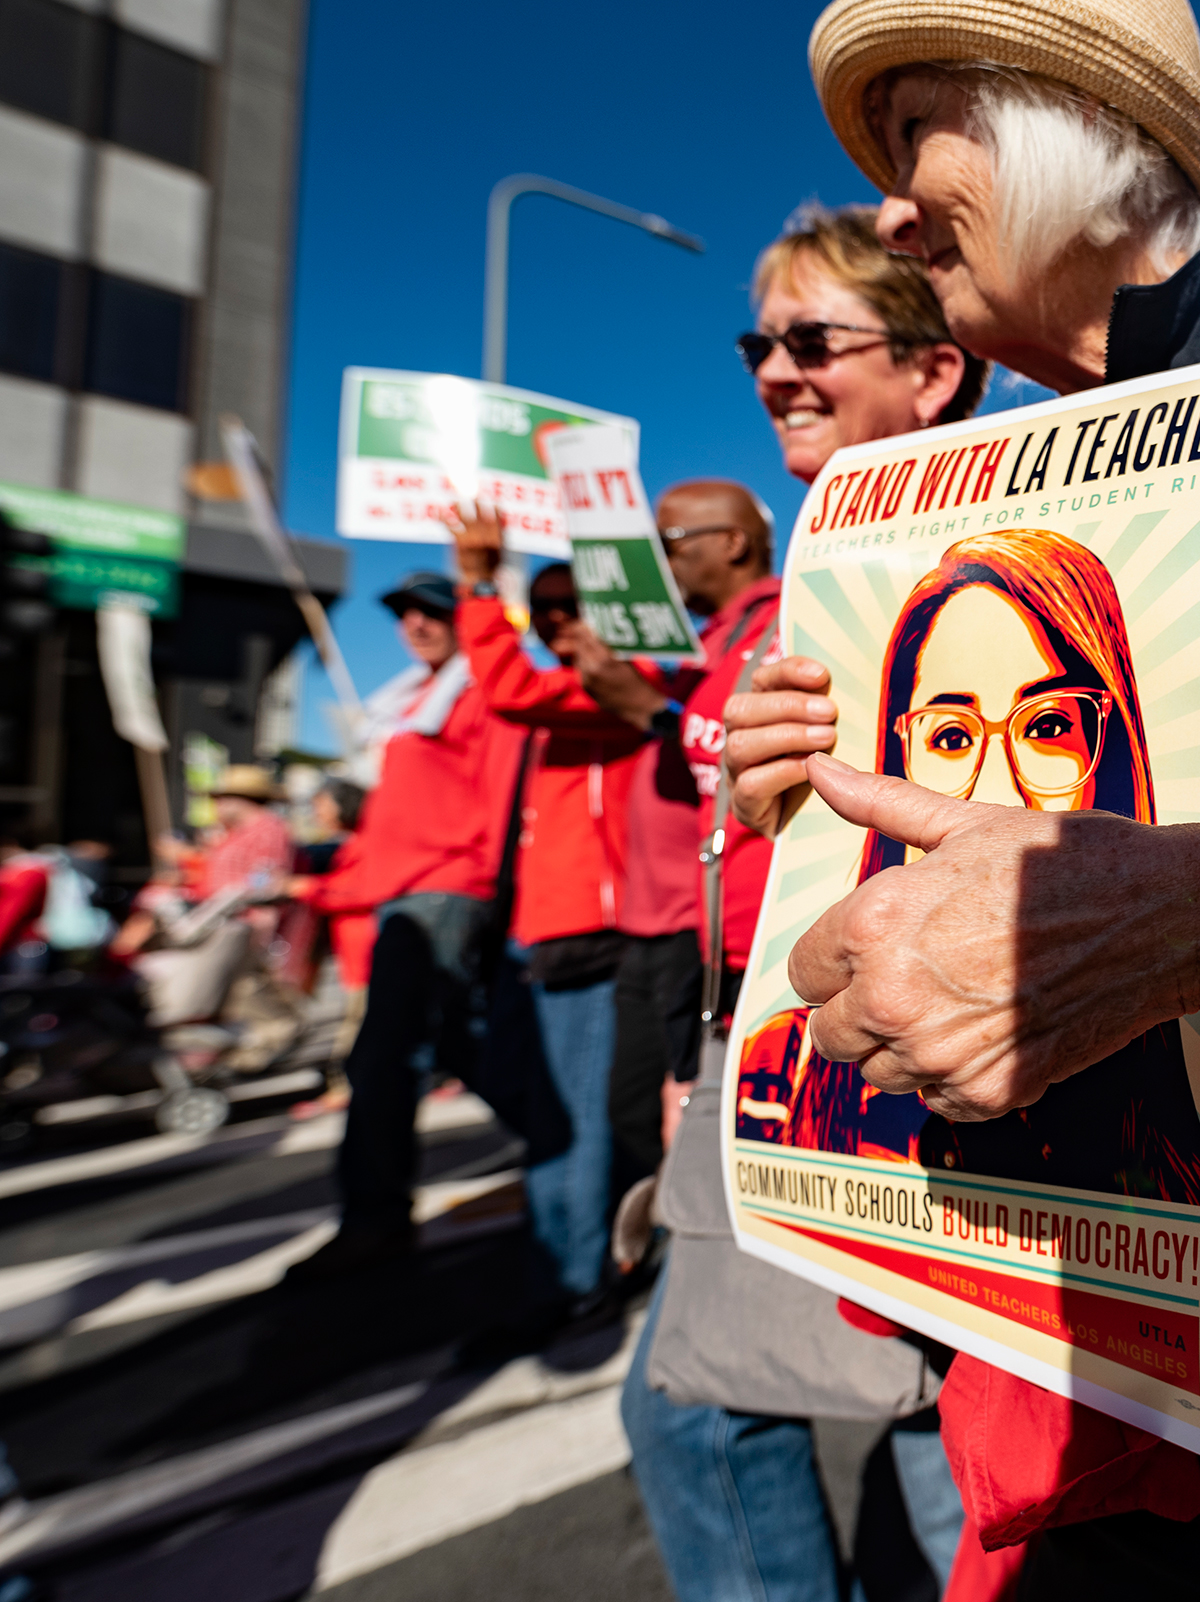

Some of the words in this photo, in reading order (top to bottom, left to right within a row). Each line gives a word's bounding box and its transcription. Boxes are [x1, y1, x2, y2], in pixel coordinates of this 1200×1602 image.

[803, 531, 896, 560] TEACHERS
[908, 517, 969, 540] FIGHT
[982, 507, 1024, 526] FOR
[1039, 483, 1154, 516] STUDENT
[810, 459, 917, 534] STAND
[912, 438, 1011, 515] WITH
[1005, 427, 1060, 498] LA
[737, 1160, 837, 1212] COMMUNITY
[845, 1179, 933, 1232] SCHOOLS
[943, 1195, 1008, 1248] BUILD
[1020, 1208, 1199, 1286] DEMOCRACY!
[928, 1266, 979, 1297] UNITED
[982, 1286, 1061, 1330] TEACHERS
[1067, 1320, 1098, 1344] LOS
[1106, 1335, 1188, 1379] ANGELES
[1138, 1320, 1187, 1352] UTLA
